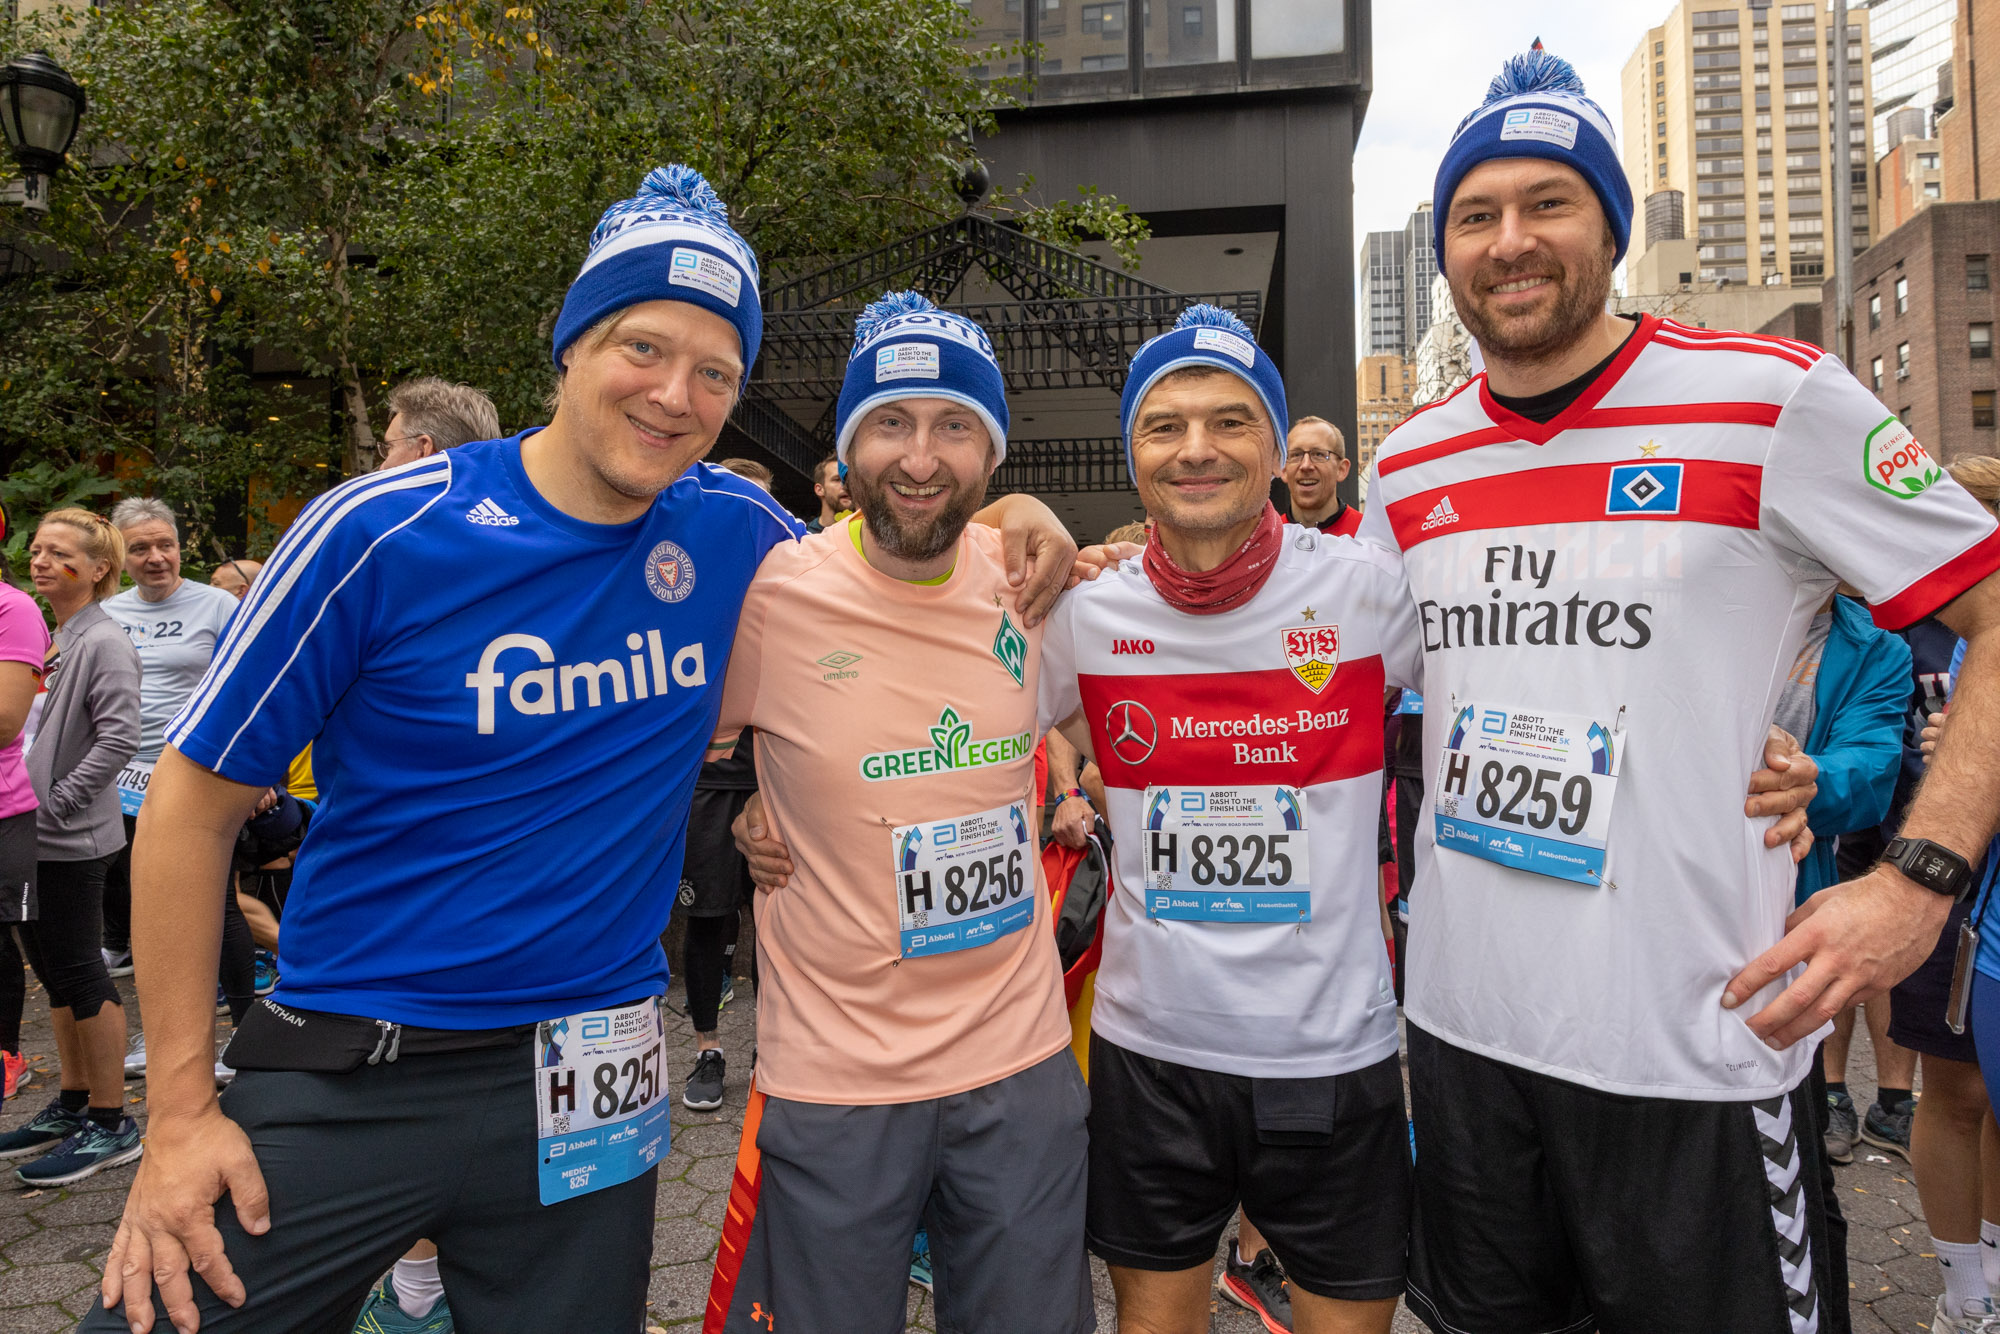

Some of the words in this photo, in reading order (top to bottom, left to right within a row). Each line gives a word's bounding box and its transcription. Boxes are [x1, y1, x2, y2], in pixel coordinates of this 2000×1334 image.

[702, 257, 724, 268] ABBOTT
[700, 262, 717, 271] DASH
[726, 272, 736, 281] THE
[700, 266, 720, 278] FINISH
[720, 274, 732, 284] LINE
[1880, 430, 1906, 454] FEINKOS
[466, 513, 520, 526] adidas
[1421, 512, 1460, 531] adidas
[647, 552, 658, 586] KIELER
[666, 544, 693, 579] HOLSTEIN
[1484, 544, 1556, 589] Fly
[656, 586, 672, 600] VON
[674, 582, 691, 600] 1900
[1418, 589, 1653, 653] Emirates
[1112, 639, 1155, 655] JAKO
[466, 628, 707, 735] famila
[823, 670, 860, 681] umbro
[1170, 708, 1350, 739] Mercedes-Benz
[1512, 714, 1544, 725] ABBOTT
[1509, 730, 1536, 740] FINISH
[1538, 734, 1558, 744] LINE
[1510, 722, 1534, 731] DASH
[1535, 725, 1546, 733] TO
[1548, 727, 1564, 736] THE
[1232, 740, 1299, 765] Bank
[1542, 754, 1566, 762] RUNNERS
[1444, 752, 1470, 796] H
[1476, 760, 1592, 836] 8259
[960, 817, 984, 828] ABBOTT
[960, 826, 978, 834] DASH
[988, 820, 998, 829] THE
[960, 832, 982, 841] FINISH
[982, 828, 996, 837] LINE
[1456, 829, 1480, 842] Abbott
[1152, 832, 1178, 873] H
[1191, 834, 1292, 886] 8325
[904, 870, 933, 914] H
[944, 849, 1024, 916] 8256
[1172, 900, 1200, 908] Abbott
[928, 932, 956, 944] Abbott
[262, 999, 306, 1027] NATHAN
[614, 1010, 641, 1021] ABBOTT
[614, 1018, 633, 1028] DASH
[634, 1017, 642, 1025] TO
[614, 1025, 637, 1036] FINISH
[638, 1021, 648, 1032] LINE
[550, 1070, 576, 1114] H
[592, 1042, 661, 1120] 8257
[568, 1136, 598, 1152] Abbott
[561, 1164, 598, 1180] MEDICAL
[569, 1174, 590, 1190] 8257
